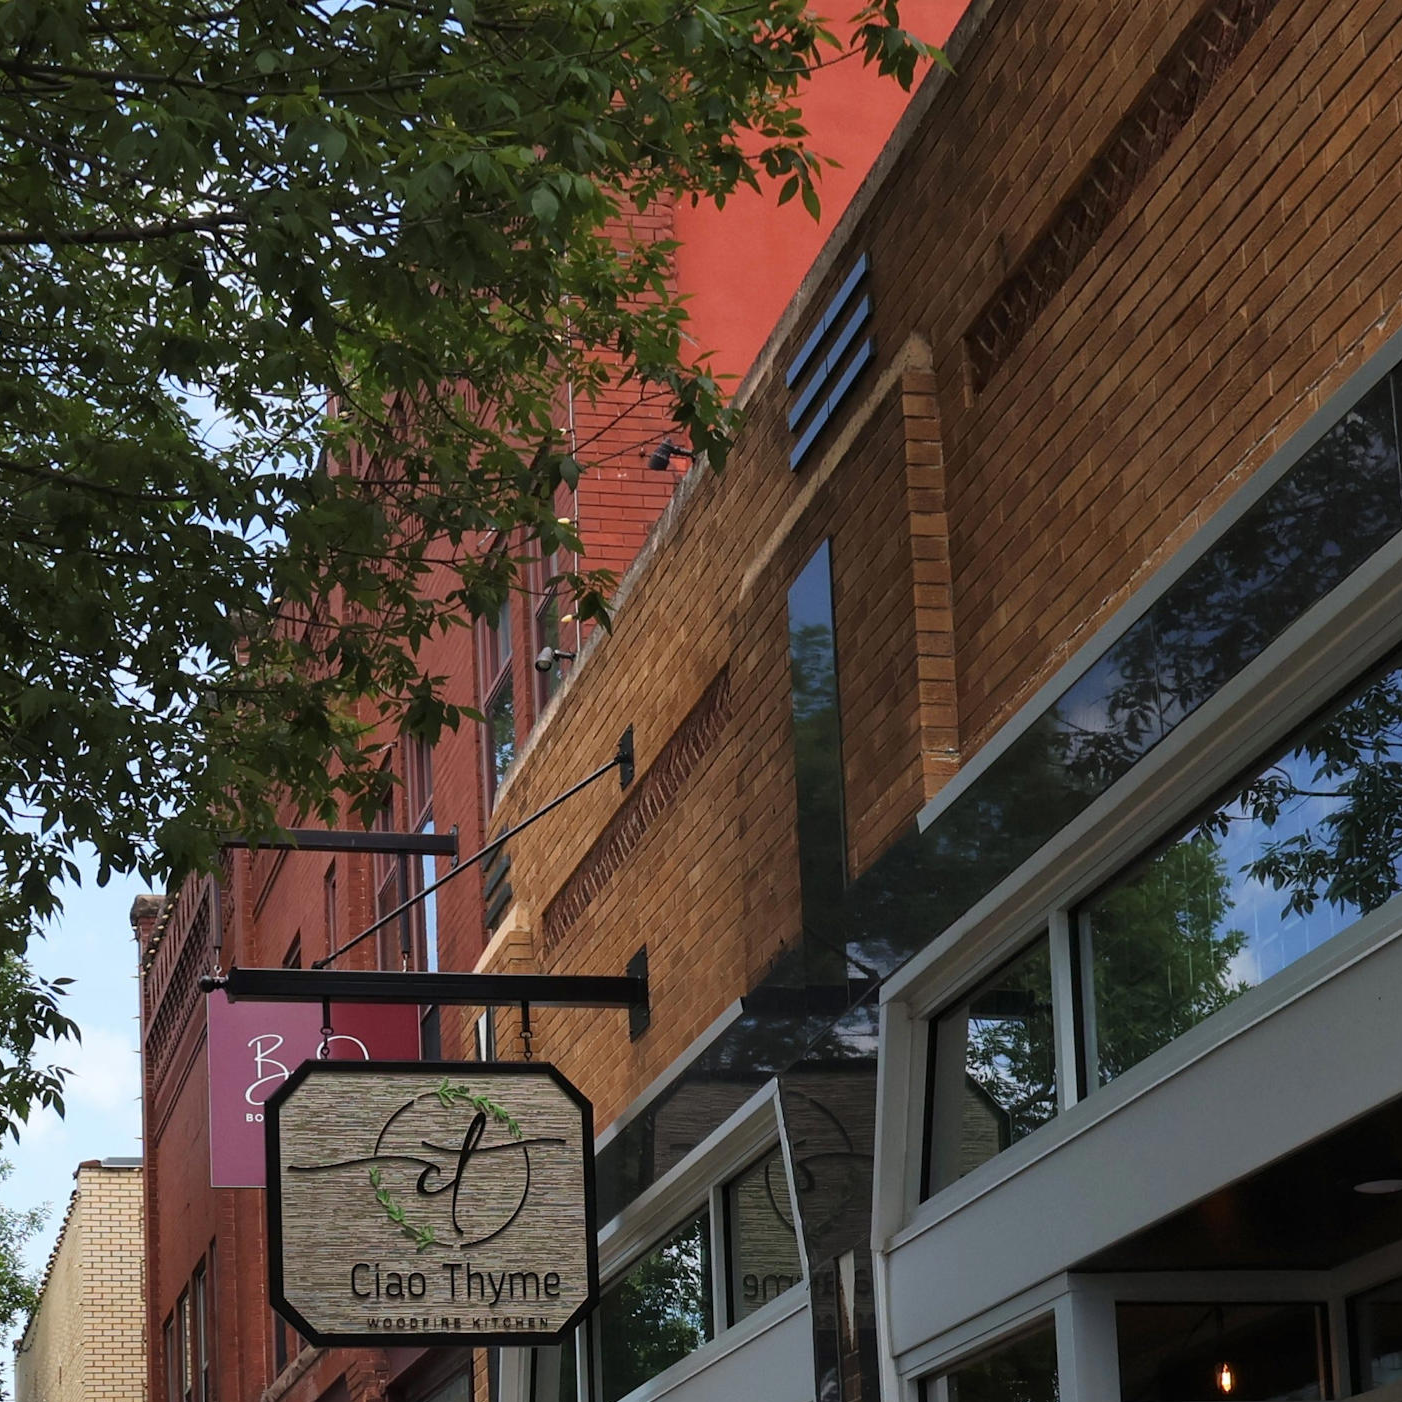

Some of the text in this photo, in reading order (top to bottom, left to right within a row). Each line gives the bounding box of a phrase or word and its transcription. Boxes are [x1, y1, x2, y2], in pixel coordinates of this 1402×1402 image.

[351, 1261, 561, 1307] Ciao Thyme
[367, 1317, 549, 1329] WOODFIRE KITCHEN
